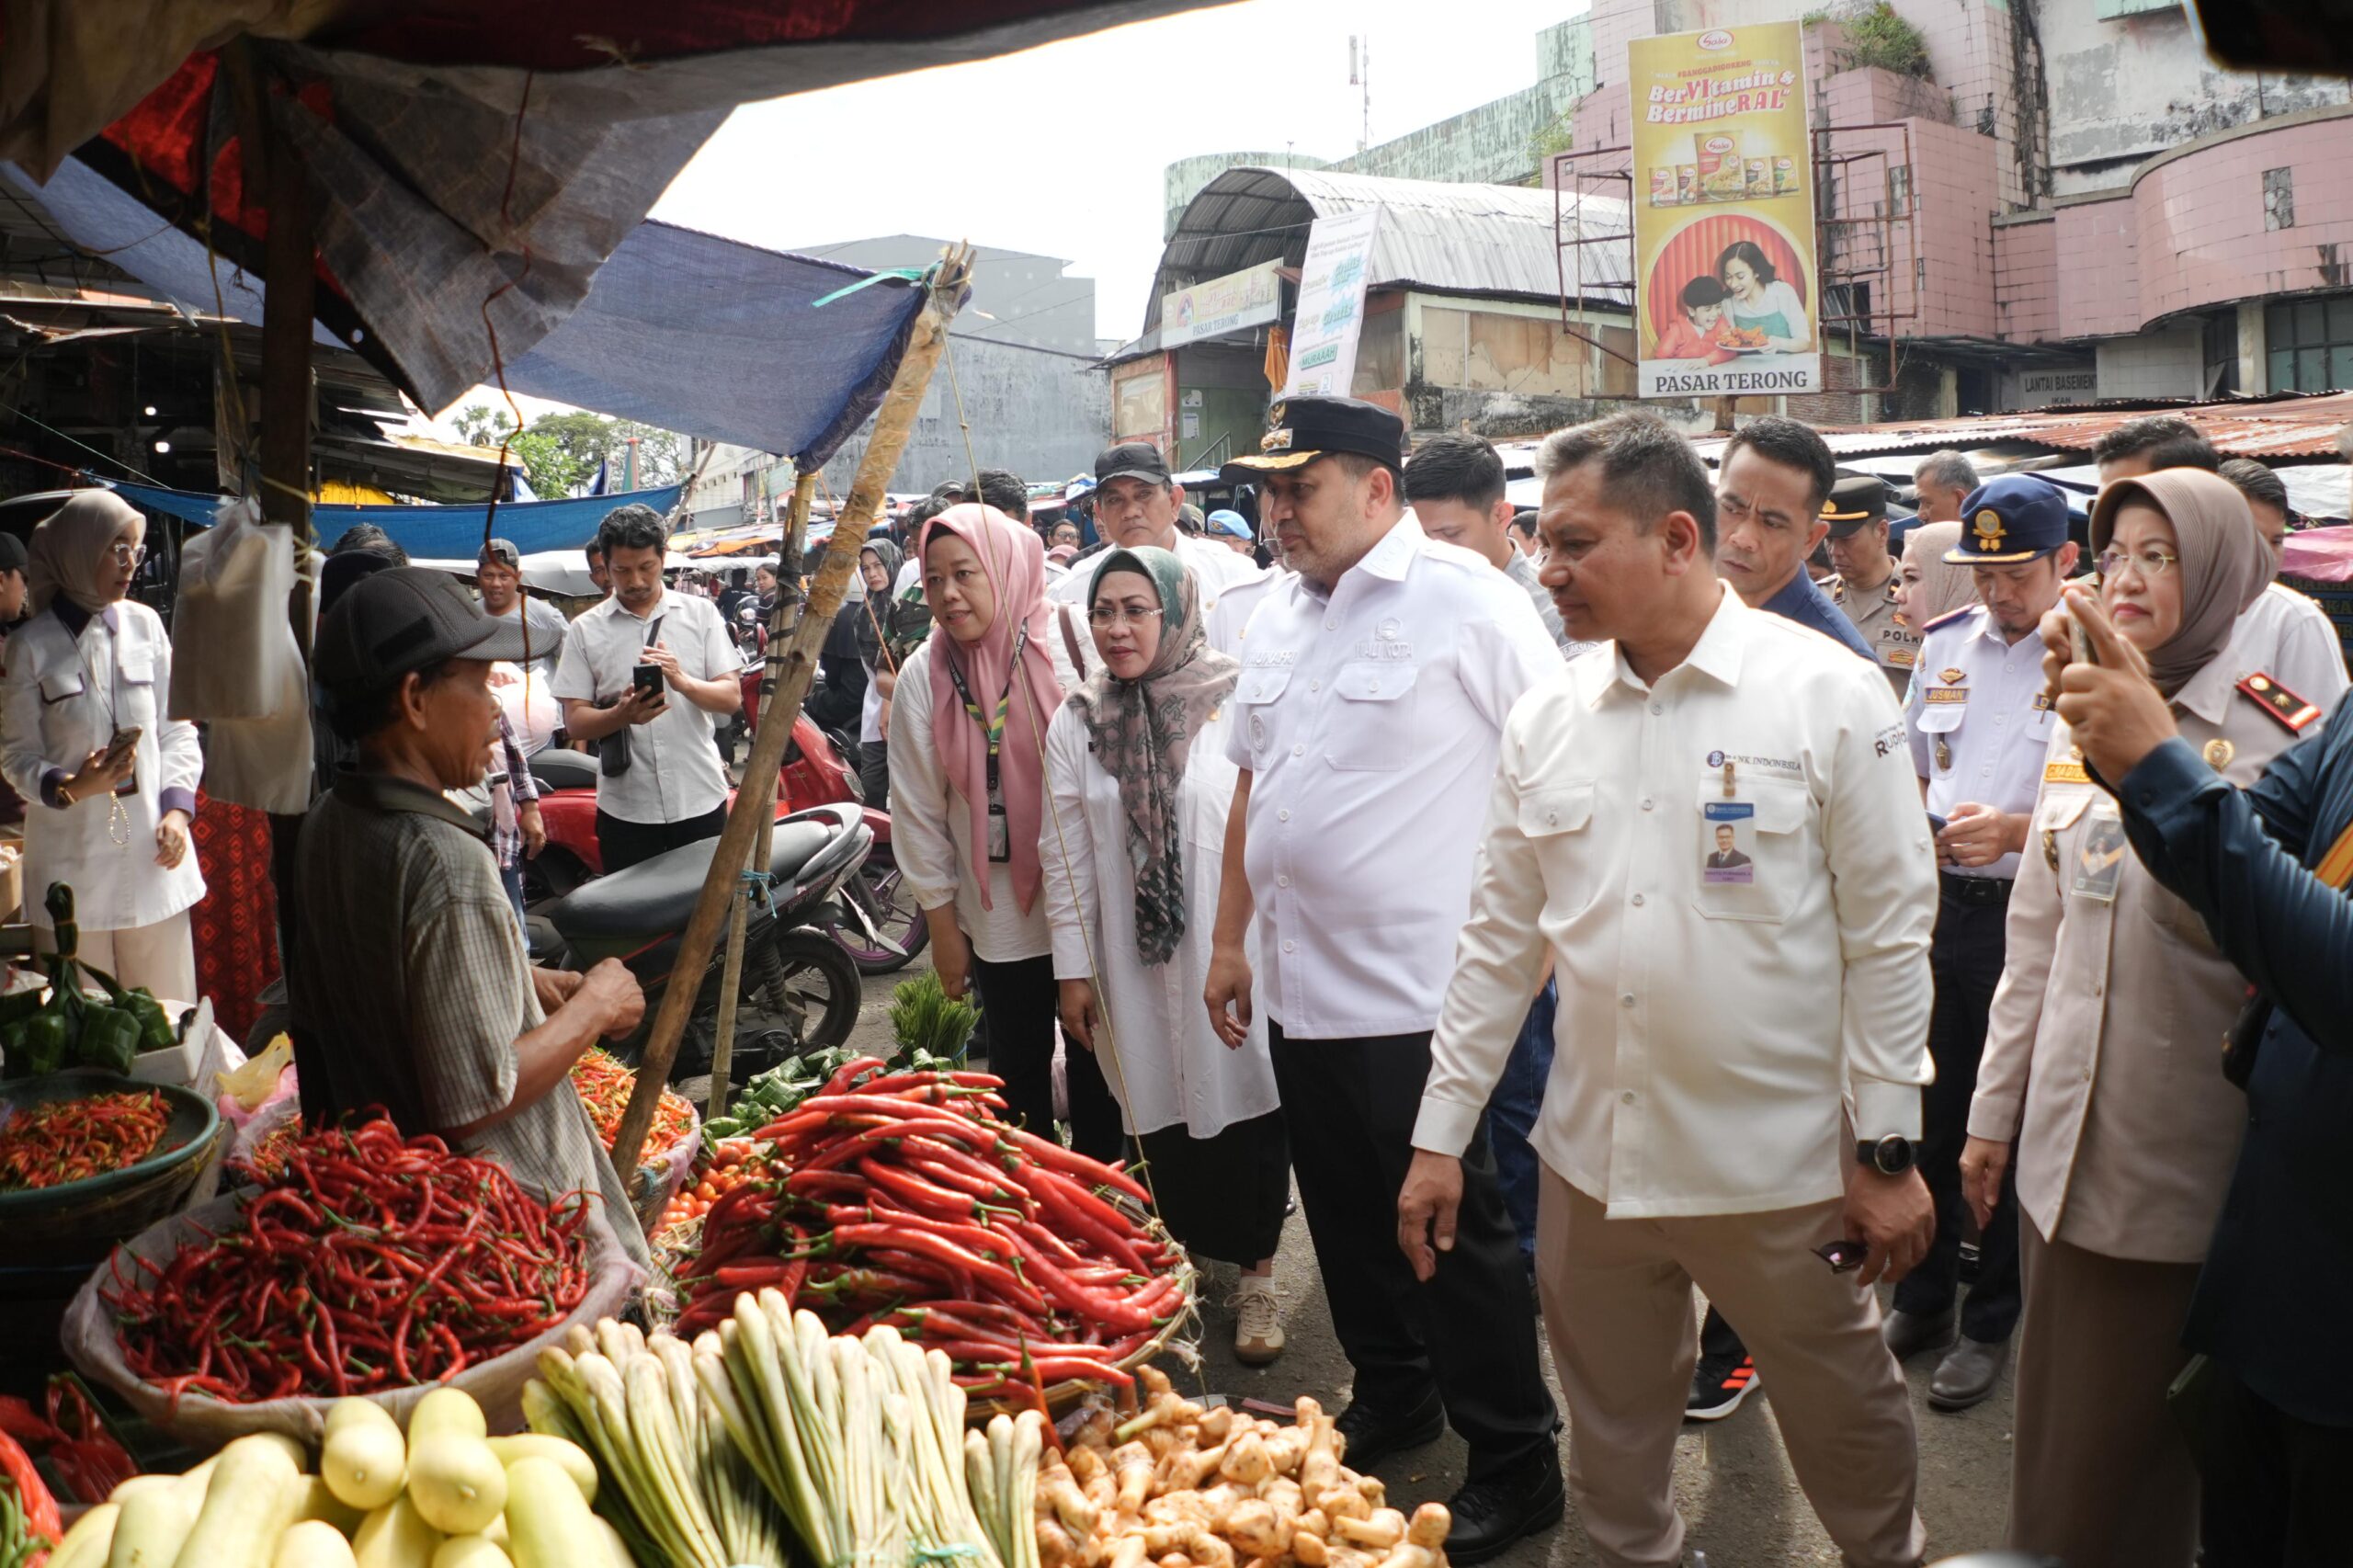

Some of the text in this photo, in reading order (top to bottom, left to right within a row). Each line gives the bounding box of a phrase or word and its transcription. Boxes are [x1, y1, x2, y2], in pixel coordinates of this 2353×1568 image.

[1779, 70, 1796, 86] &
[1193, 314, 1239, 336] PASAR TERONG
[1655, 370, 1808, 392] PASAR TERONG
[2025, 376, 2053, 392] LANTAI
[1928, 688, 1963, 699] JUSMAN
[1753, 756, 1802, 771] INDONESIA
